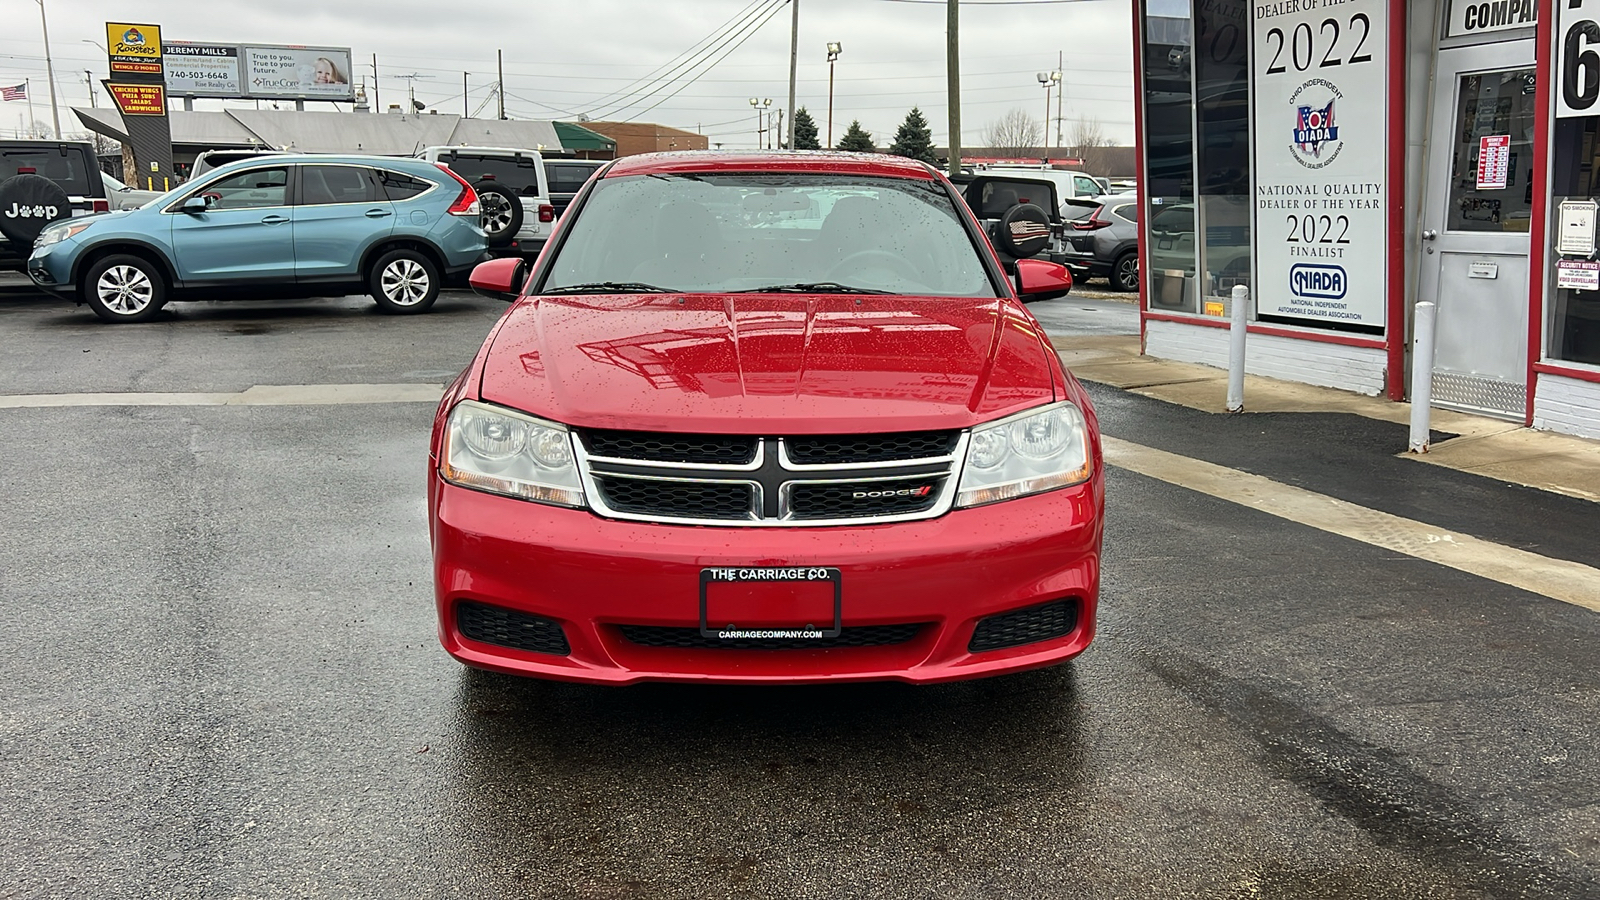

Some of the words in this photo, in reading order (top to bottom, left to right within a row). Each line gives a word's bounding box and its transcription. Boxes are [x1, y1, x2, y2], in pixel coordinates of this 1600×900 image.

[1256, 0, 1300, 19] DEALER
[1302, 0, 1318, 10] OF
[114, 42, 156, 55] Roosters
[1266, 12, 1372, 75] 2022
[1563, 19, 1600, 111] 6
[169, 71, 228, 79] 740-503-6648
[208, 81, 226, 89] Realty
[261, 78, 300, 87] TrueCore
[1289, 86, 1303, 105] OHIO
[1302, 78, 1344, 100] INDEPENDENT
[1298, 128, 1331, 142] OIADA
[1288, 144, 1307, 168] AUTOMOBILE
[1307, 162, 1324, 170] DEALERS
[1323, 141, 1344, 167] ASSOCIATION
[1258, 184, 1319, 195] NATIONAL
[1323, 183, 1382, 197] QUALITY
[1260, 199, 1300, 209] DEALER
[1304, 199, 1318, 209] OF
[1322, 199, 1344, 209] THE
[1349, 199, 1380, 209] YEAR
[1286, 214, 1350, 244] 2022
[1290, 246, 1345, 258] FINALIST
[1294, 271, 1342, 292] NIADA
[1290, 299, 1314, 307] NATIONAL
[1314, 301, 1347, 310] INDEPENDENT
[1277, 306, 1307, 315] AUTOMOBILE
[1307, 309, 1328, 317] DEALERS
[1328, 311, 1362, 320] ASSOCIATION
[852, 487, 922, 499] DODGE
[710, 569, 736, 580] THE
[739, 568, 806, 580] CARRIAGE
[808, 568, 830, 580] CO.
[718, 631, 823, 639] CARRIAGECOMPANY.COM
